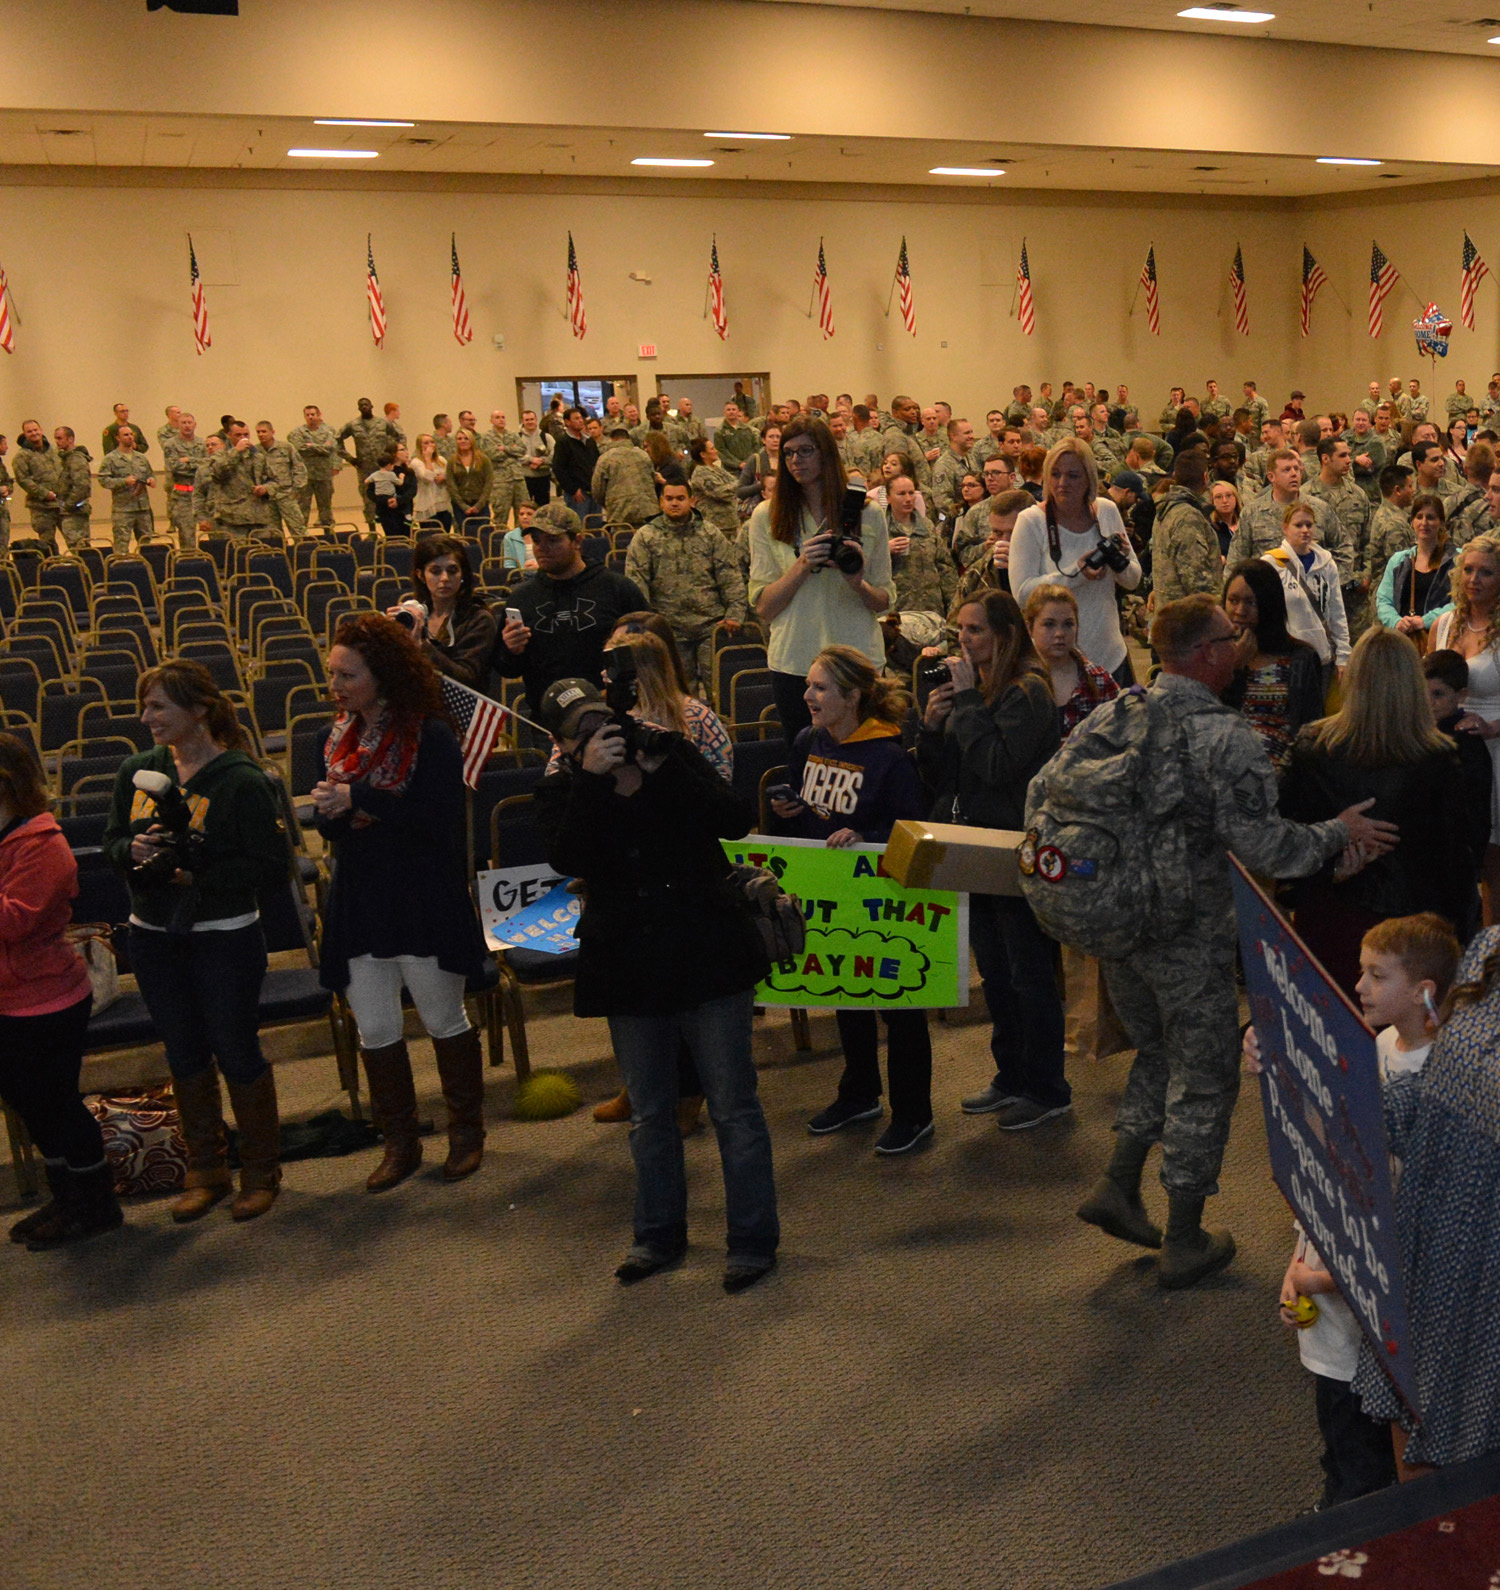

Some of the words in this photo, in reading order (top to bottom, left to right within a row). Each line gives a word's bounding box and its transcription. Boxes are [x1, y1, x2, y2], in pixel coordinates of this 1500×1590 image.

[507, 899, 582, 944] WELCO
[862, 898, 951, 932] THAT
[778, 953, 901, 981] BAYNE
[1291, 1165, 1383, 1342] debriefed
[1338, 1185, 1360, 1249] to
[1360, 1216, 1390, 1294] be
